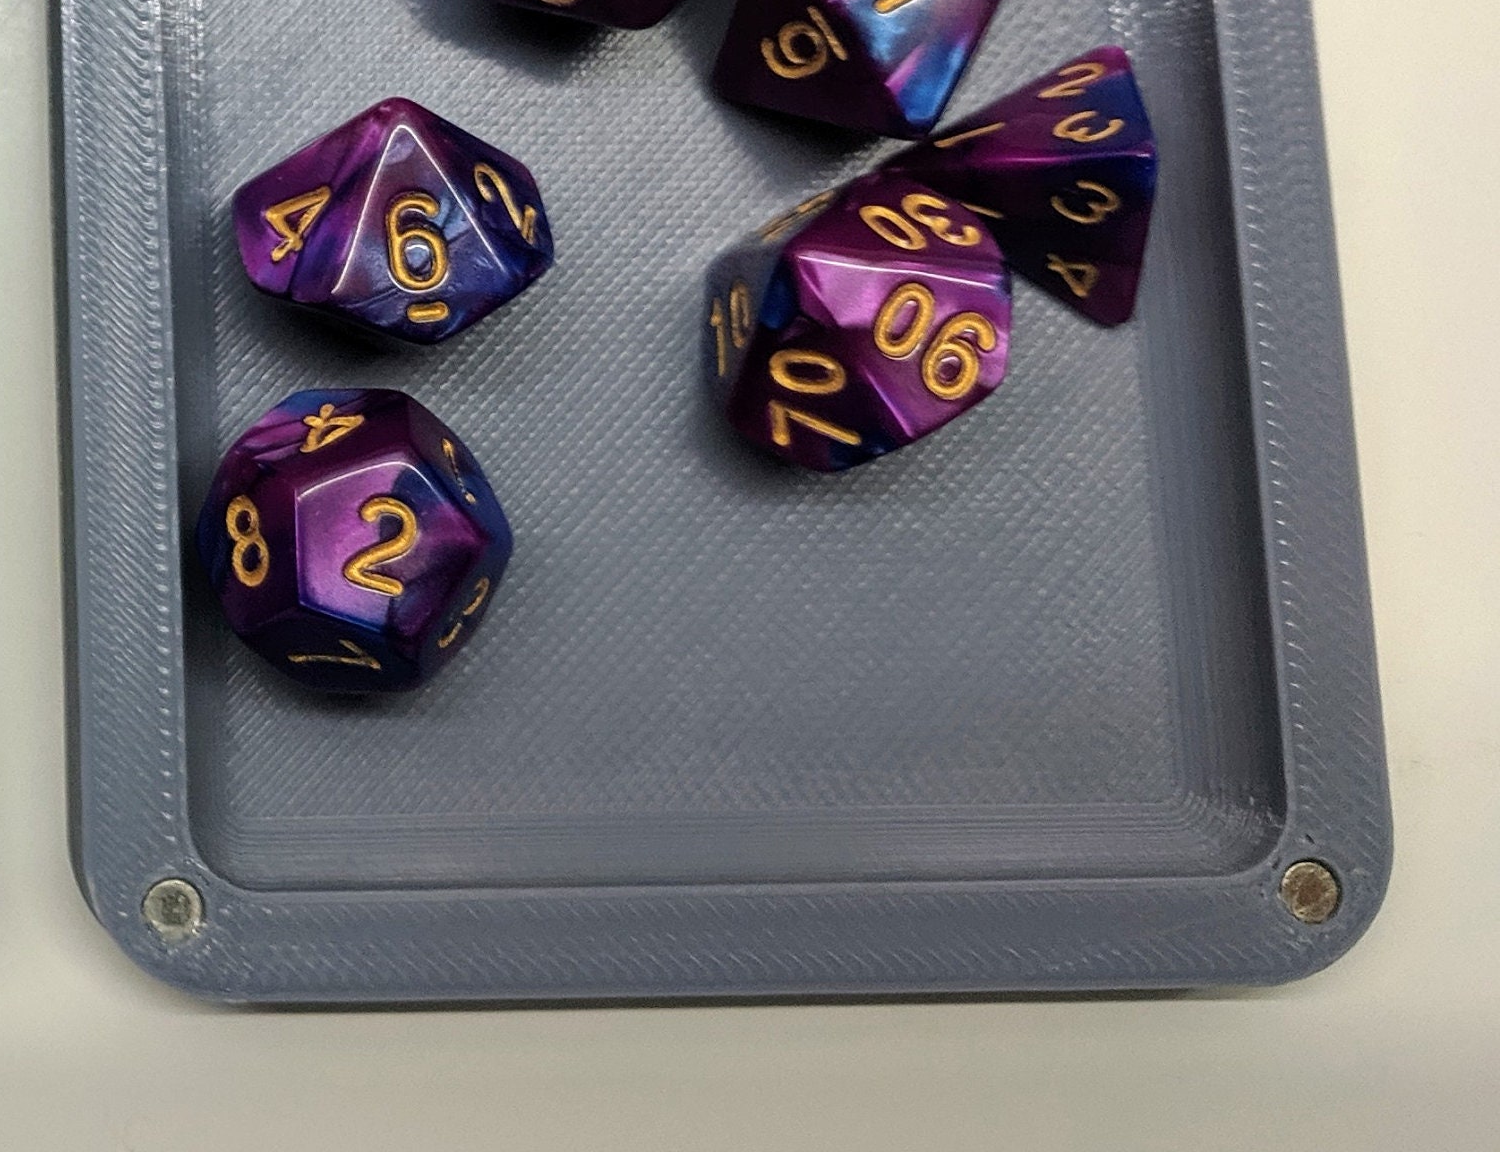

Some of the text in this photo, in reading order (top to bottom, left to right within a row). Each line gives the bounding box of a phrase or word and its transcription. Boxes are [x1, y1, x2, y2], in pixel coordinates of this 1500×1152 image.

[1038, 61, 1106, 100] 2
[264, 185, 332, 261] 4
[473, 161, 538, 245] 2
[858, 192, 984, 251] 30
[1050, 178, 1122, 225] 3
[299, 403, 366, 454] 4
[767, 347, 863, 448] 70
[225, 495, 271, 588] 8
[342, 496, 419, 597] 2
